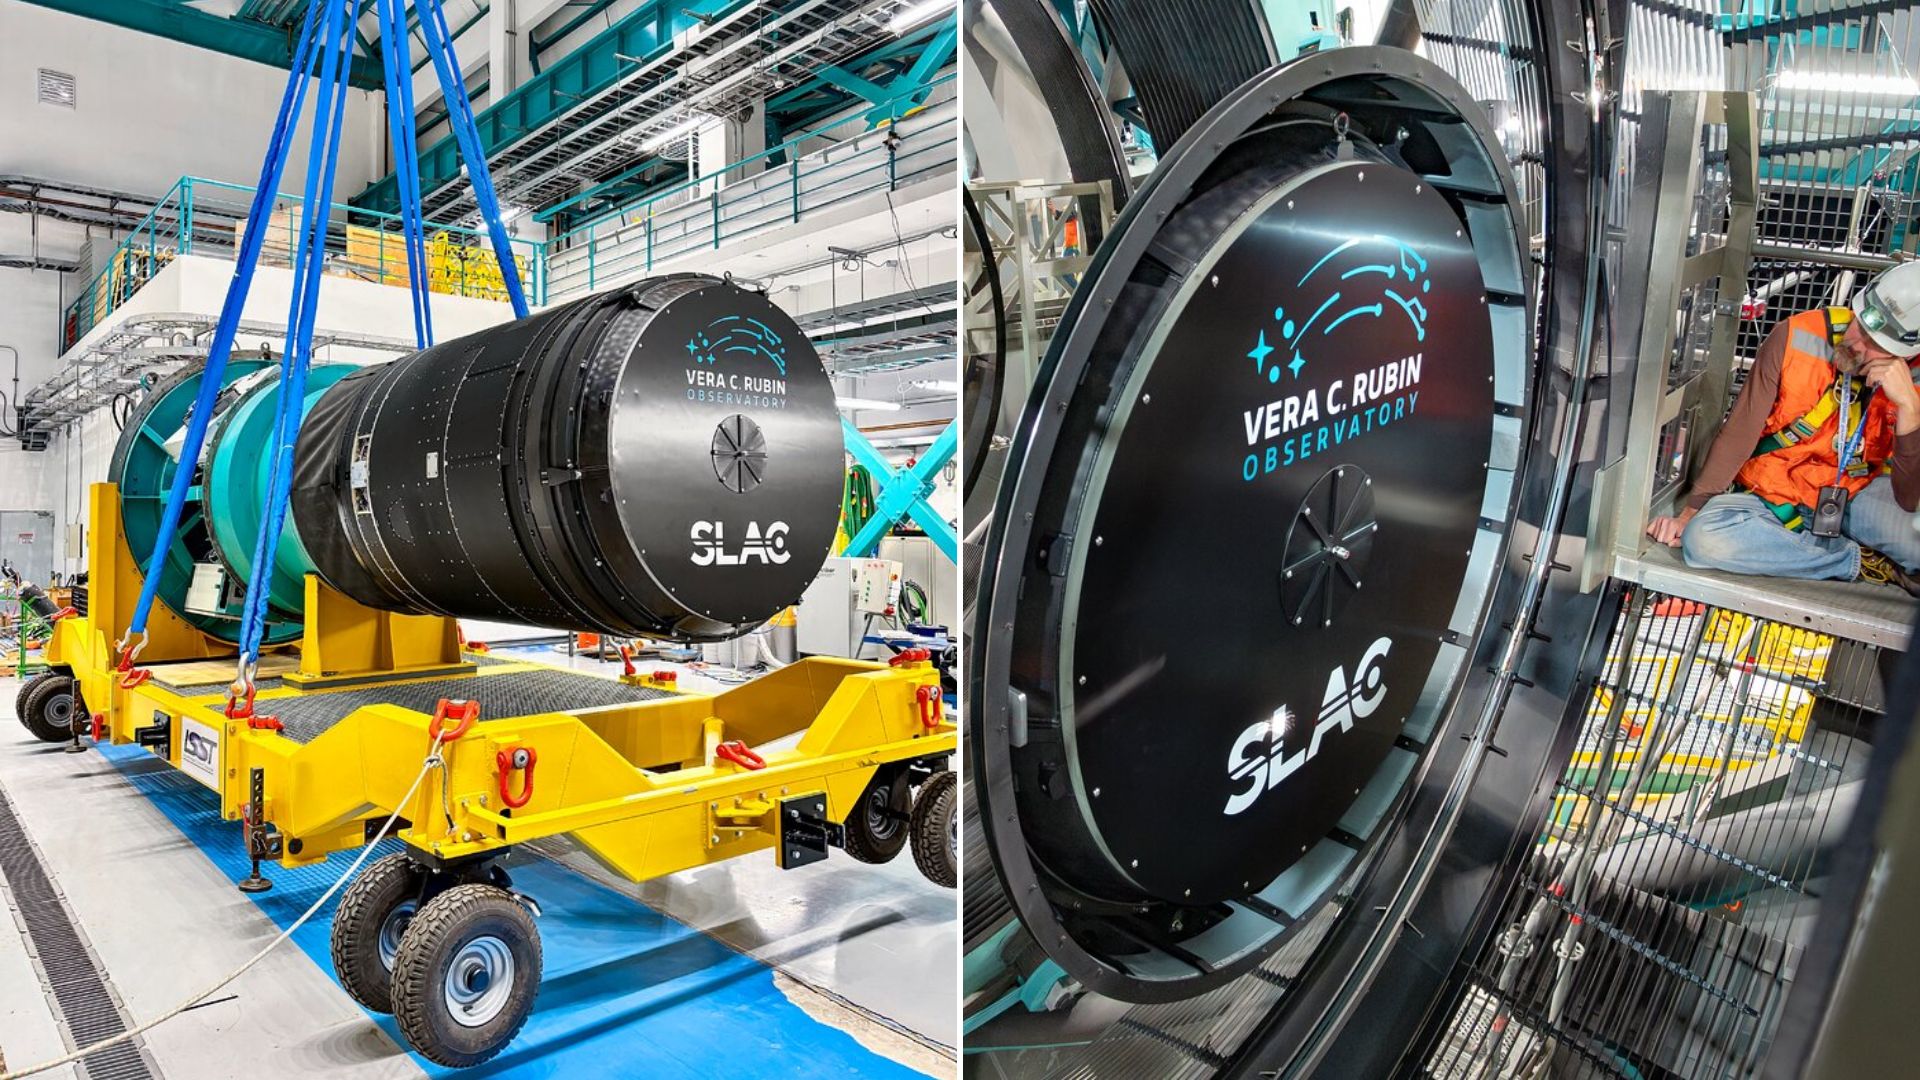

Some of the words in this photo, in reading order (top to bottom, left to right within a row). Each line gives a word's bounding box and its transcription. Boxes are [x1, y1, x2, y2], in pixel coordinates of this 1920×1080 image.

[685, 369, 726, 389] VERA
[729, 374, 742, 390] C.
[744, 376, 786, 395] RUBIN
[686, 388, 787, 409] OBSERVATORY
[1243, 388, 1319, 446] VERA
[1326, 379, 1347, 416] C.
[1352, 353, 1422, 407] RUBIN
[1242, 391, 1419, 481] OBSERVATORY
[690, 520, 791, 567] SLAC
[1223, 636, 1393, 816] SLAC
